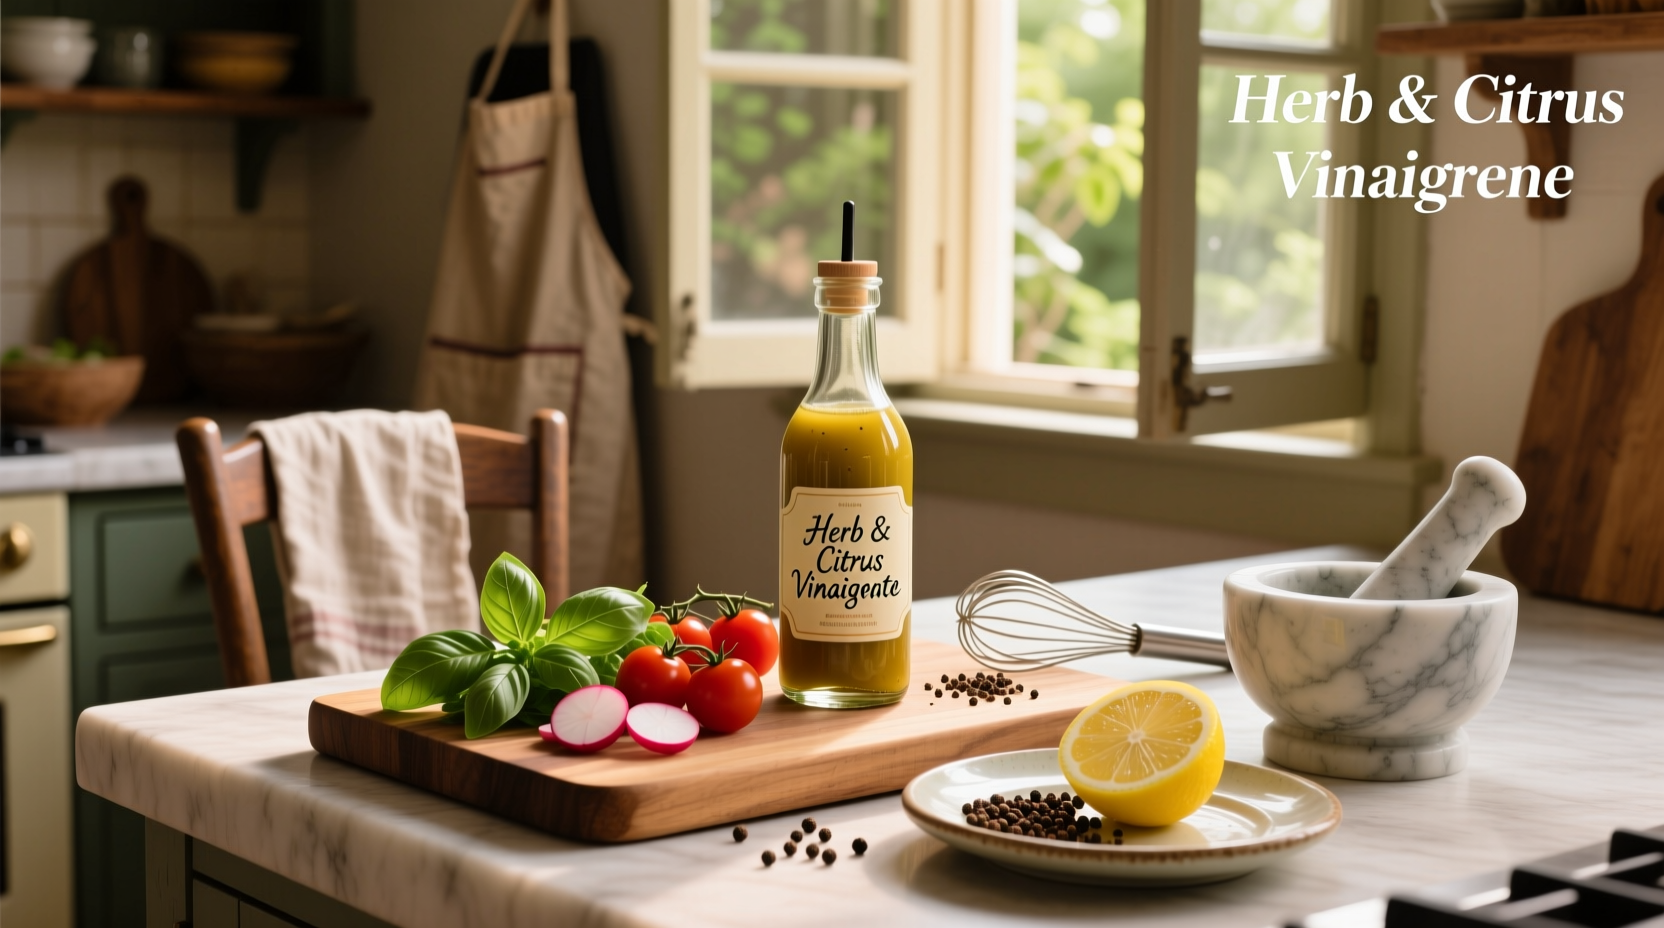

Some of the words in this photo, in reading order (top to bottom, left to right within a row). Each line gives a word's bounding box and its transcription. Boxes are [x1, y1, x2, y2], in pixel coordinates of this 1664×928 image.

[803, 513, 864, 546] Herb
[871, 515, 891, 542] &
[816, 545, 884, 573] Citrus
